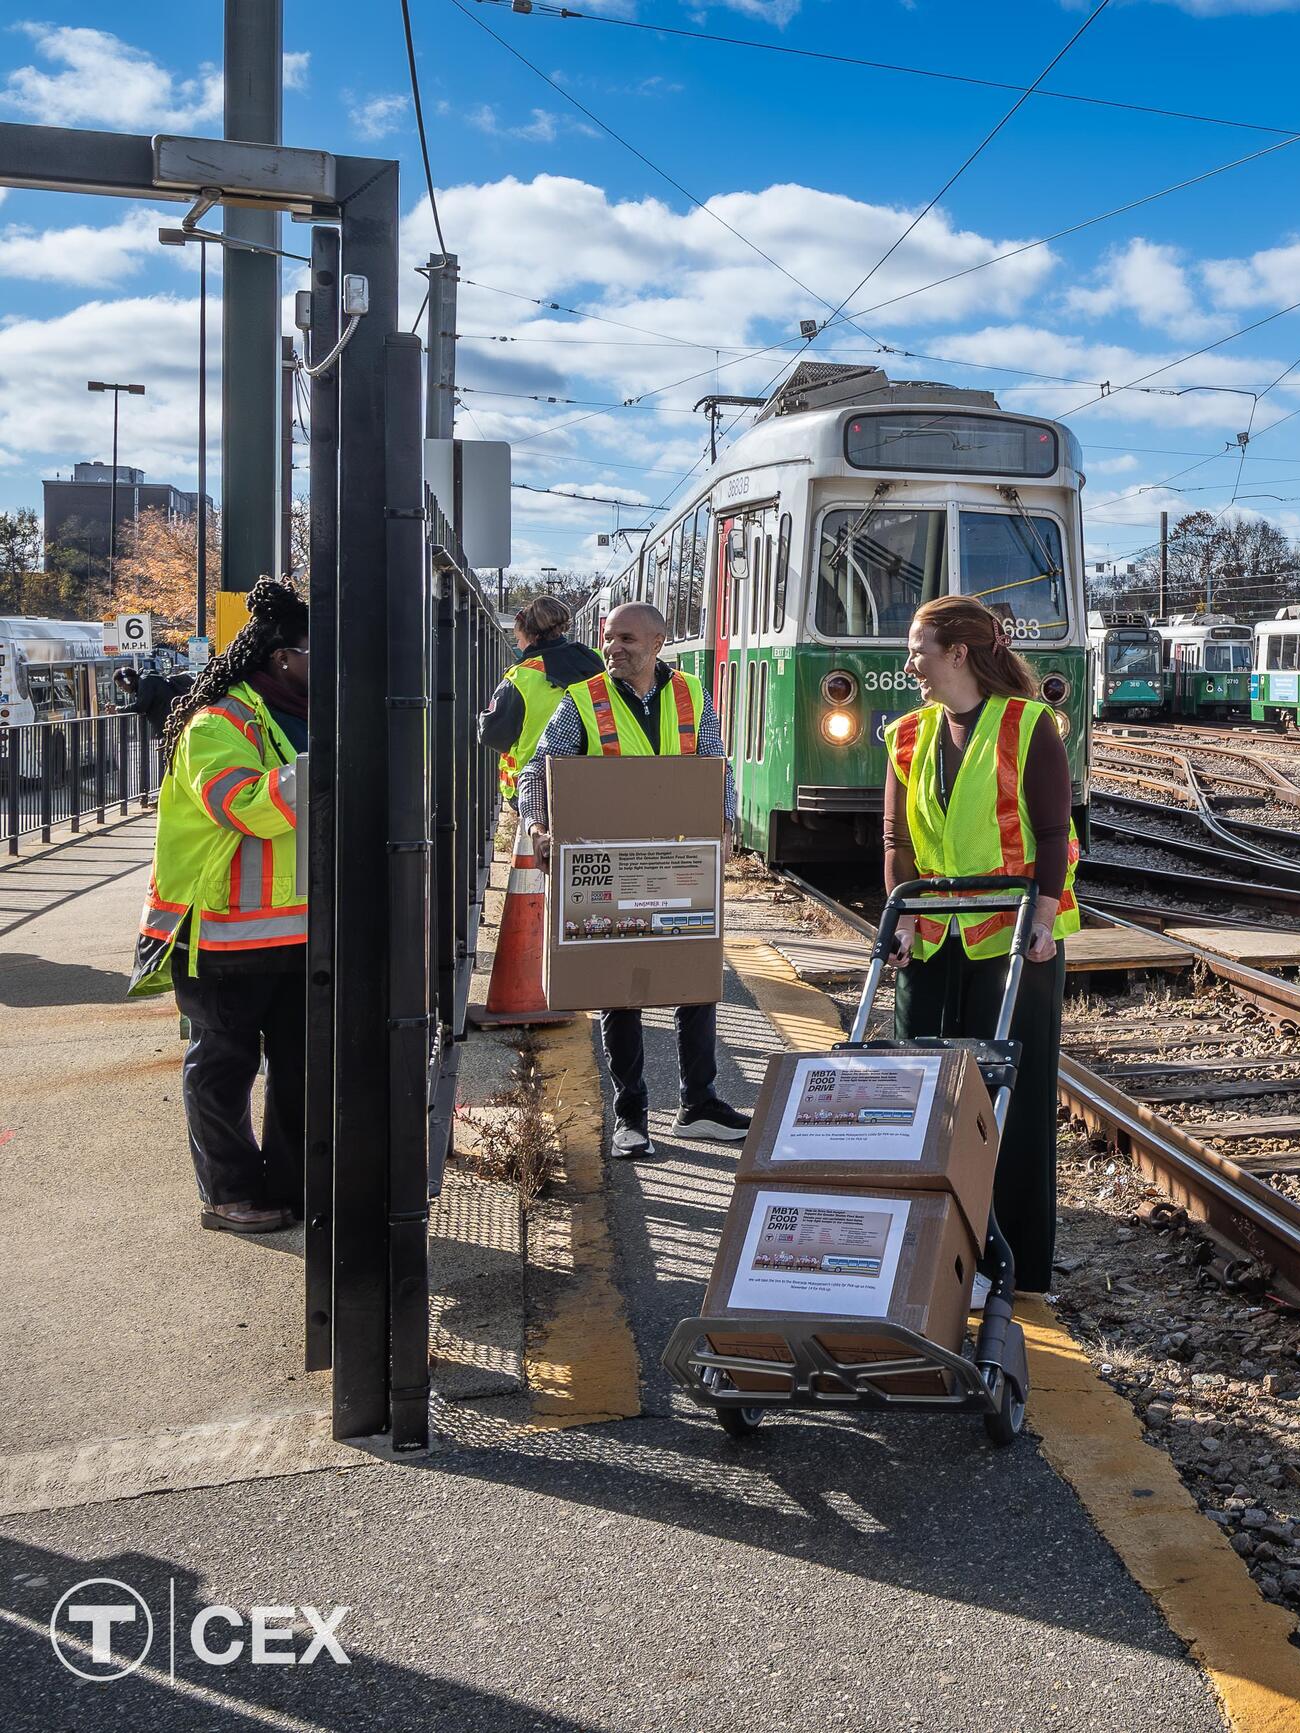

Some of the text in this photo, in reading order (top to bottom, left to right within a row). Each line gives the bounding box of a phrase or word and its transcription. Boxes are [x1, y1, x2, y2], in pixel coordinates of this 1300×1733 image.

[125, 618, 144, 639] 6
[1002, 617, 1041, 639] 683
[121, 642, 149, 650] M.P.H.
[864, 671, 921, 690] 3683
[572, 853, 611, 864] MBTA
[572, 864, 611, 875] FOOD
[571, 875, 614, 886] DRIVE
[808, 1084, 836, 1092] DRIVE
[771, 1207, 799, 1215] MBTA
[767, 1223, 798, 1231] DRIVE
